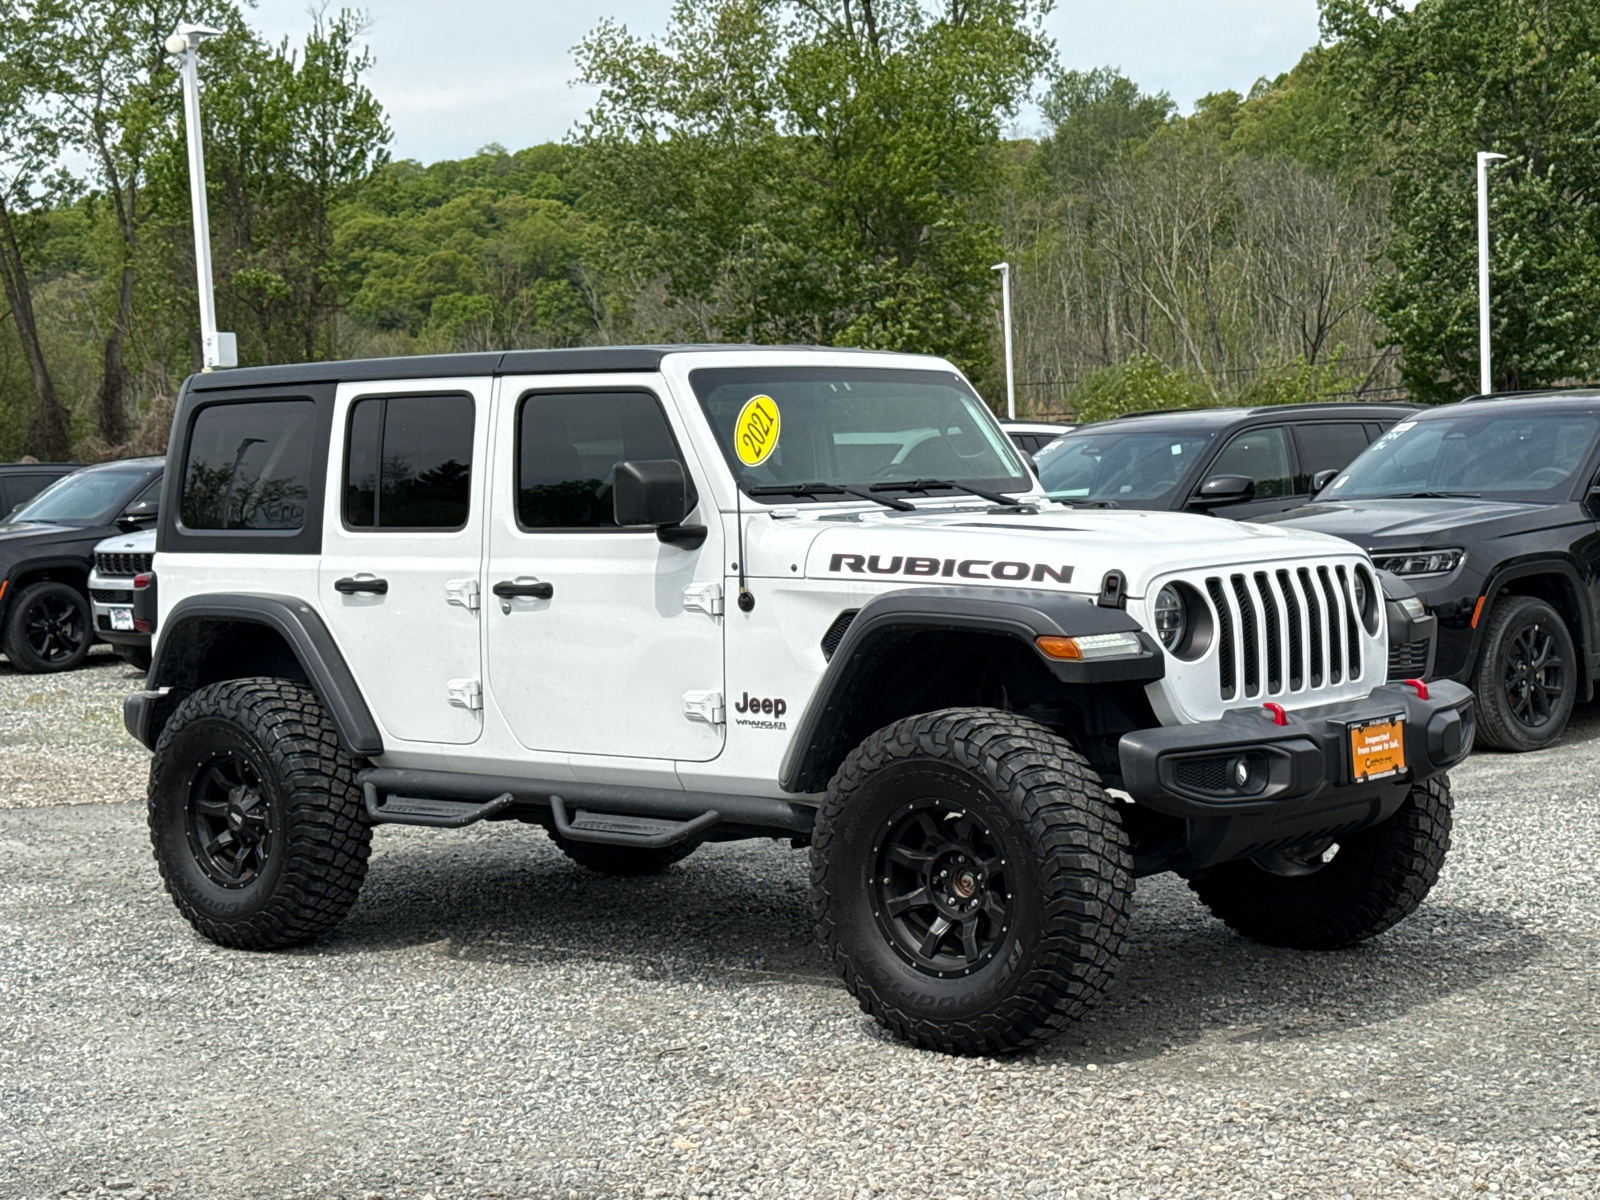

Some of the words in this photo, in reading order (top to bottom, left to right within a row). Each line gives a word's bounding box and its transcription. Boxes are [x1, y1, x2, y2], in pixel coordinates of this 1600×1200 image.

[742, 401, 774, 459] 2021
[828, 553, 1075, 584] RUBICON
[734, 691, 787, 719] Jeep
[735, 719, 786, 727] WRANGLER
[1357, 746, 1370, 755] from
[1371, 745, 1382, 753] nose
[1383, 742, 1389, 750] to
[1365, 733, 1390, 744] Inspected
